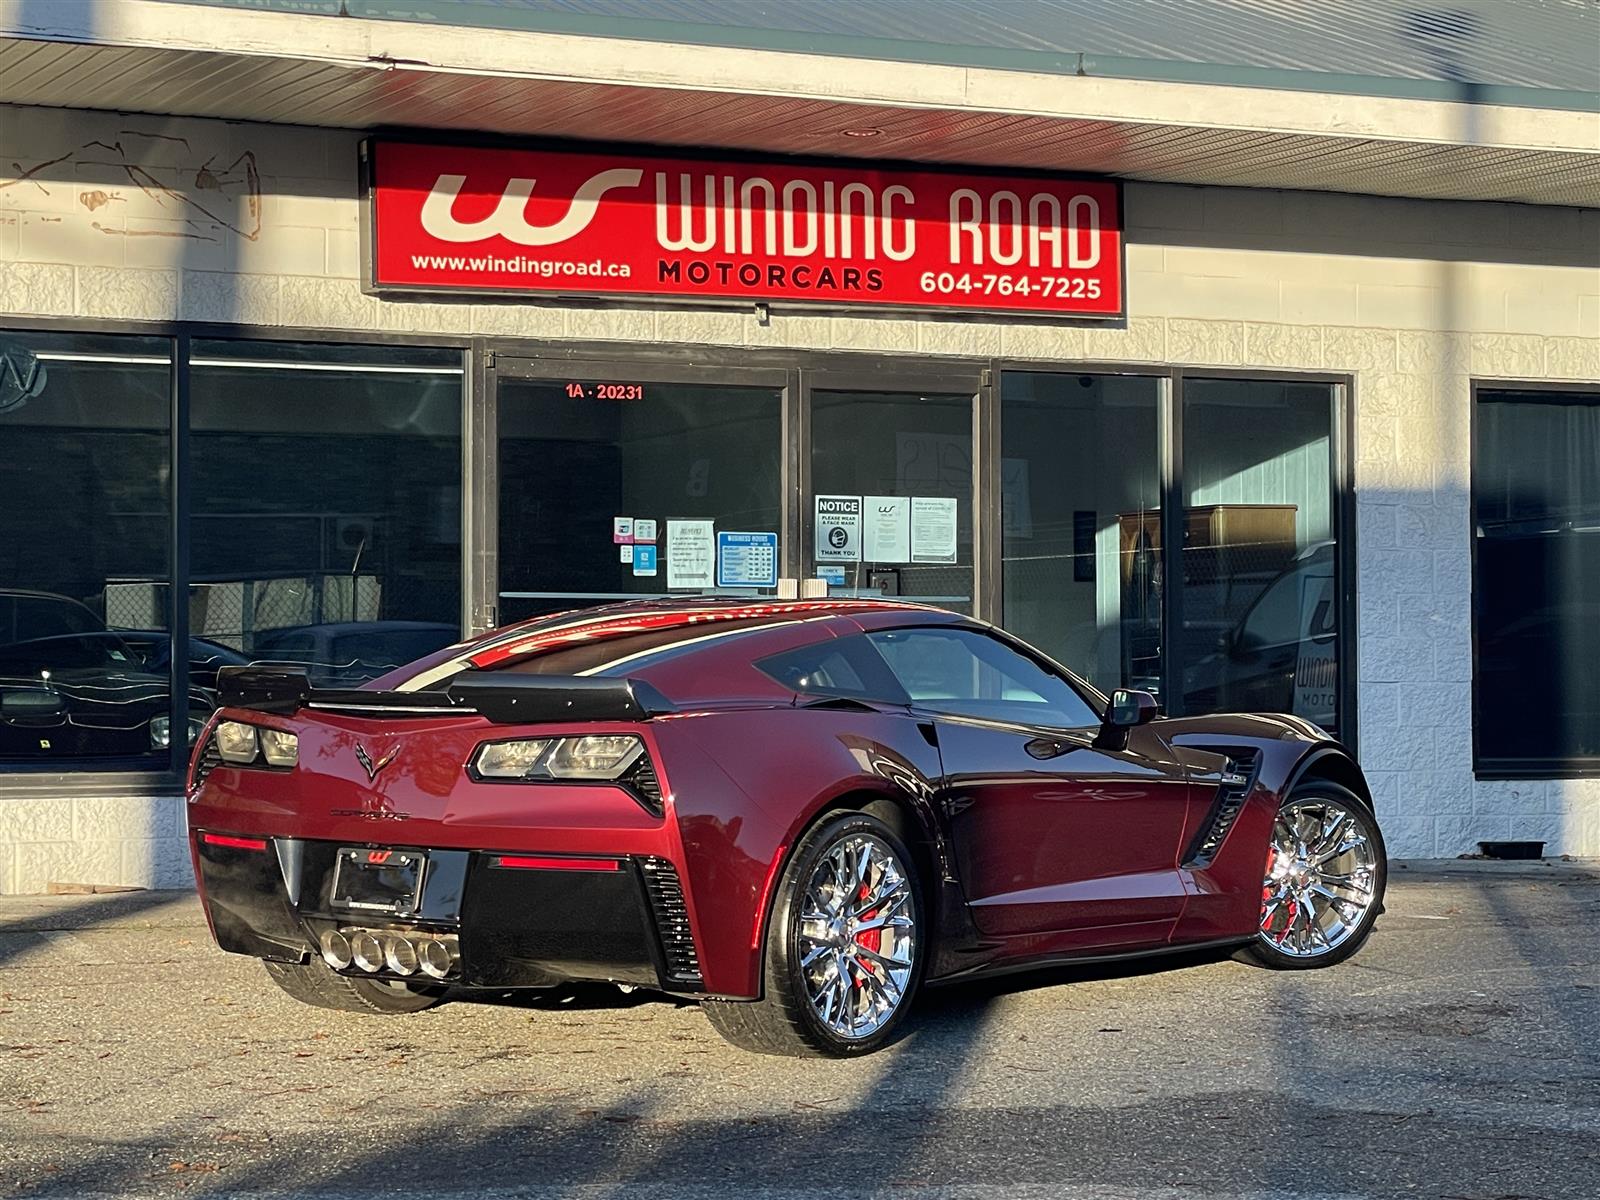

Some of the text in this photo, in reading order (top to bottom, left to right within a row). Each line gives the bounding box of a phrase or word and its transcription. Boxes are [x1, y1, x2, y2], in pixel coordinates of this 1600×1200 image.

[655, 171, 1102, 270] WINDING ROAD
[411, 254, 632, 278] www.windingroad.ca
[658, 259, 883, 291] MOTORCARS
[919, 270, 1102, 300] 604-764-7225
[566, 383, 584, 398] 1A
[597, 384, 642, 400] 20231
[819, 500, 858, 512] NOTICE
